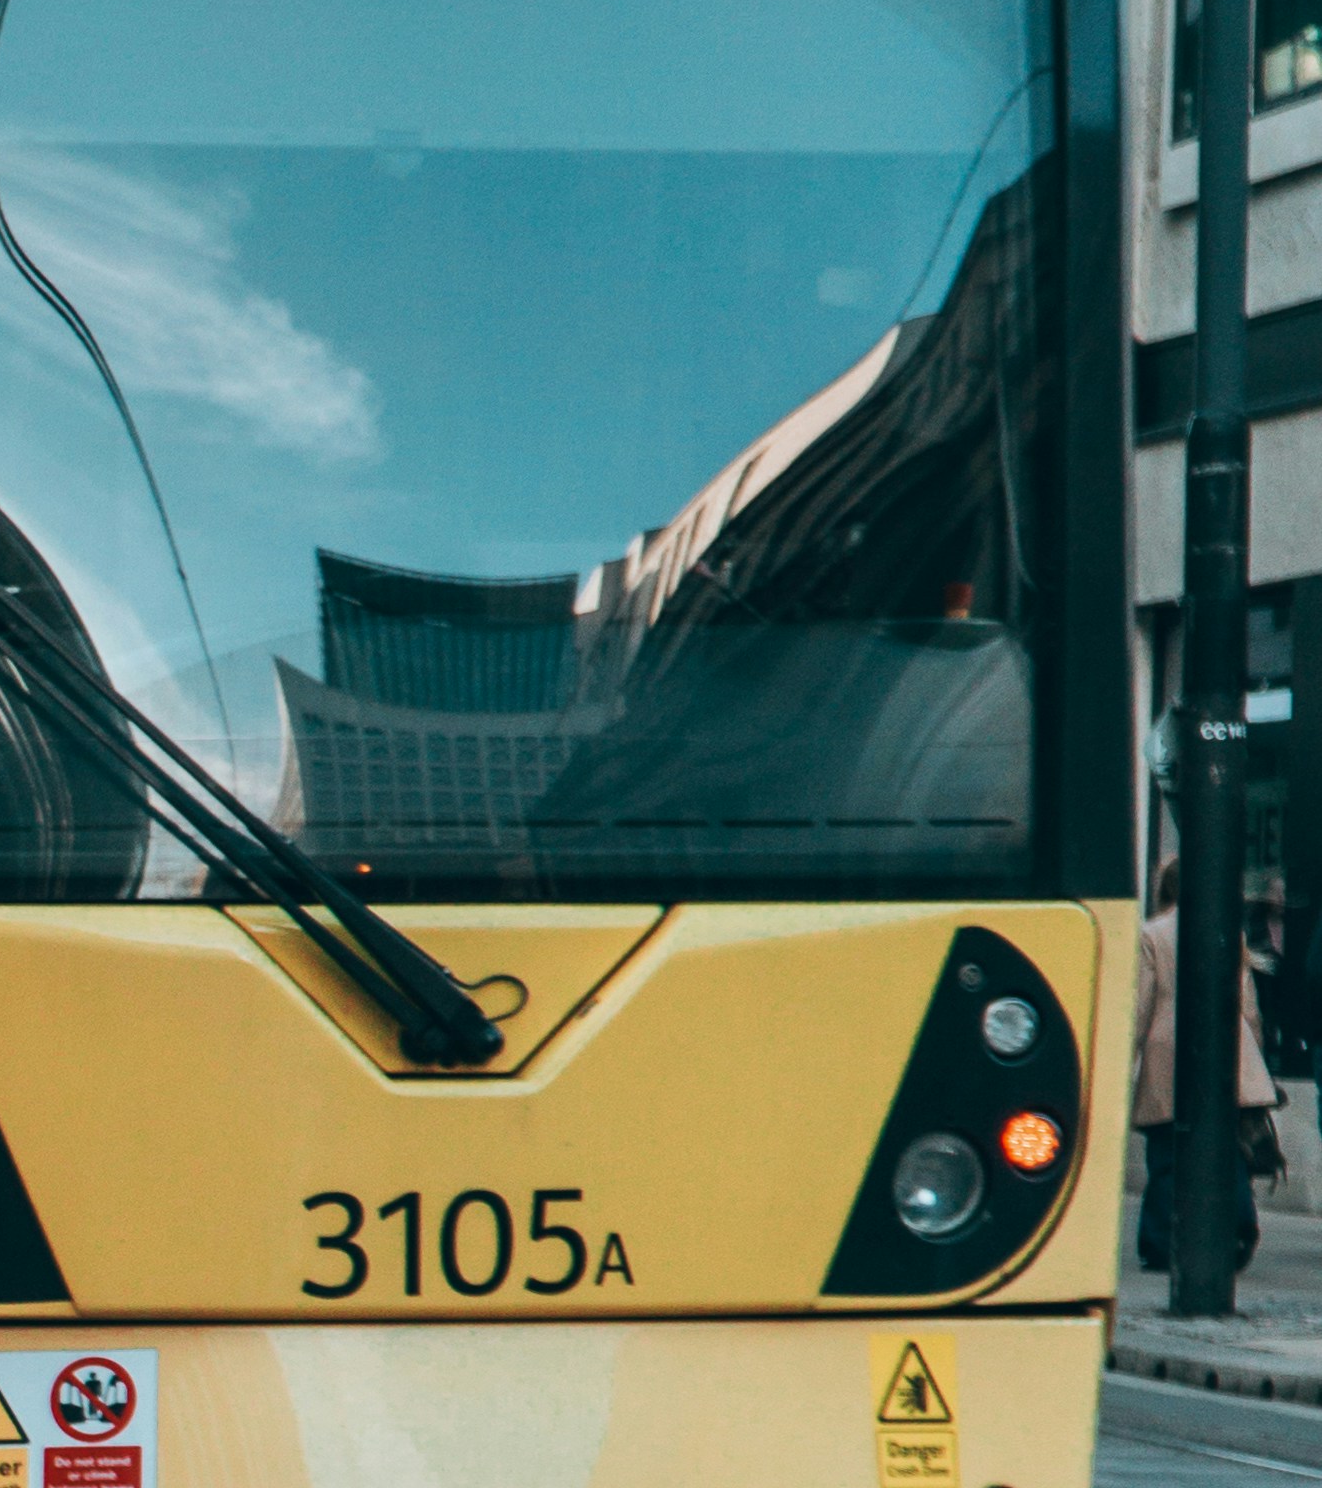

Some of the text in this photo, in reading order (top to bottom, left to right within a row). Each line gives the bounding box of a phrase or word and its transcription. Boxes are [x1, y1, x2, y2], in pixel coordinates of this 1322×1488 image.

[54, 1455, 132, 1468] Do not stand
[67, 1470, 118, 1481] or climb
